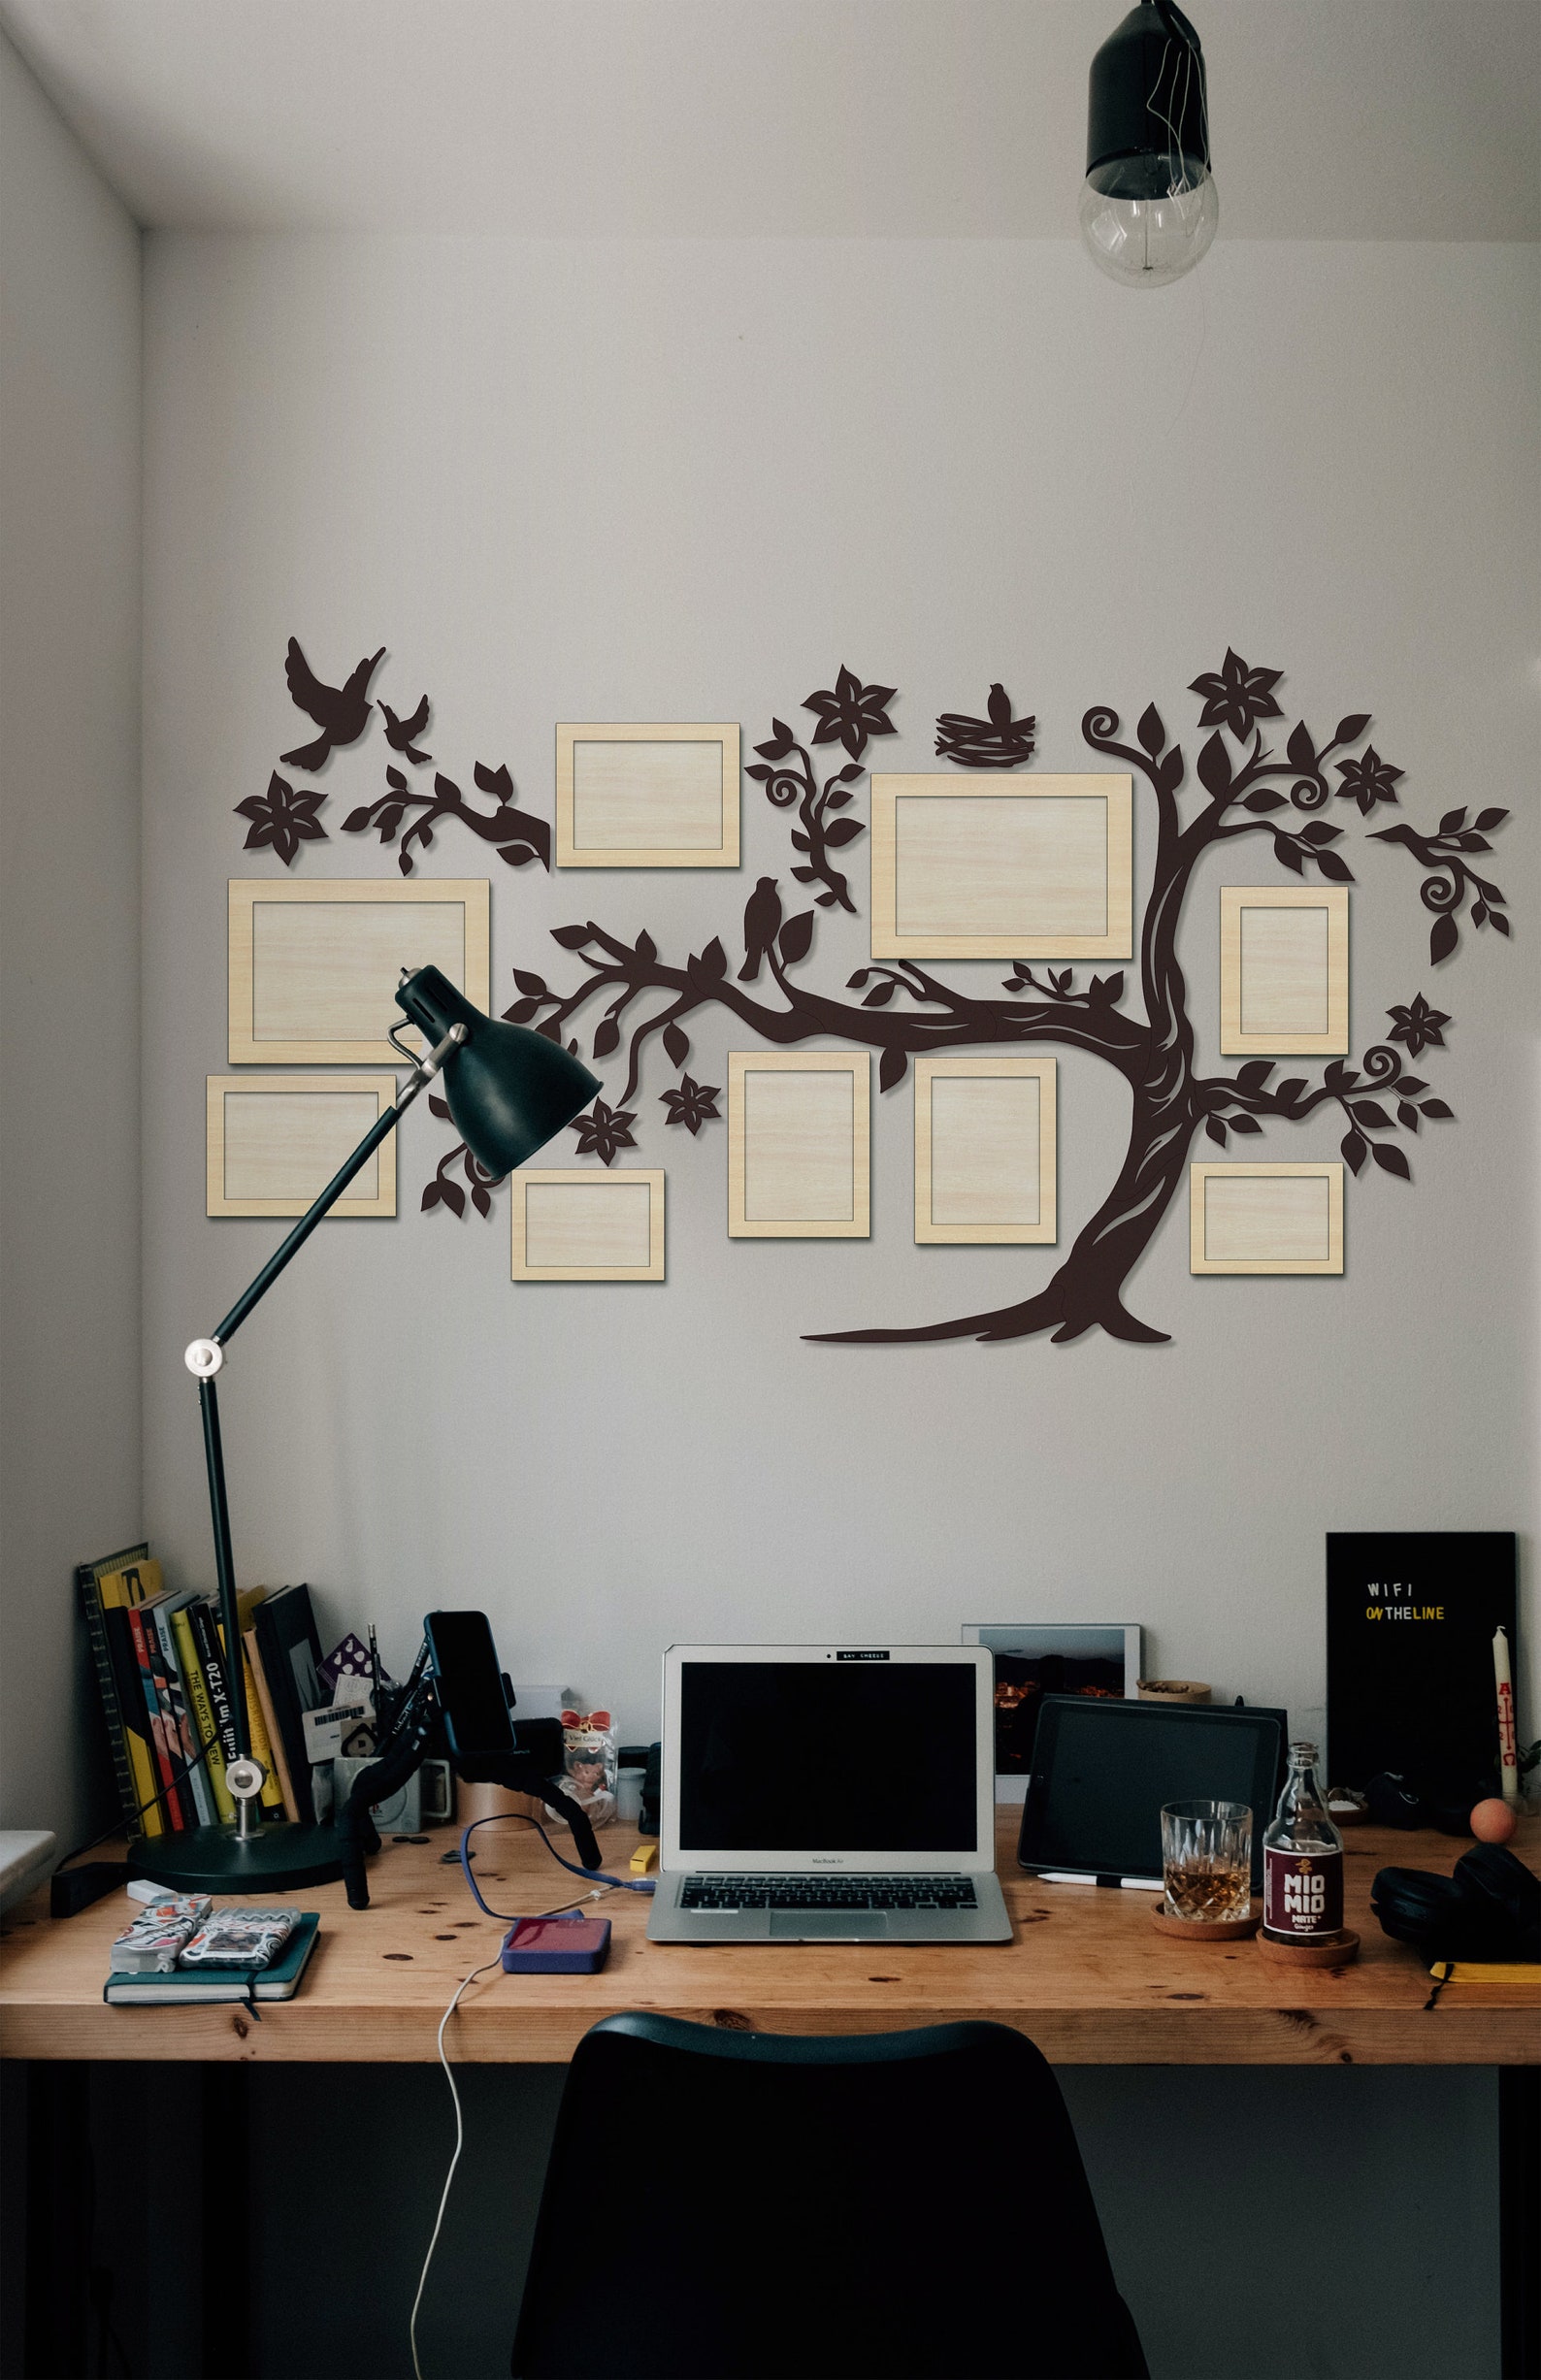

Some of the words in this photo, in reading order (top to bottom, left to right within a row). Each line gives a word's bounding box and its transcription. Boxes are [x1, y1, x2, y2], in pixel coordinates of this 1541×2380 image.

[1367, 1582, 1412, 1597] WIFI
[134, 1627, 145, 1653] PRAISE
[159, 1626, 170, 1652] PRAISE
[206, 1662, 227, 1704] X-T20
[189, 1671, 203, 1690] THE
[196, 1692, 210, 1721] WAYS
[203, 1723, 213, 1739] TO
[1284, 1874, 1325, 1894] MIO
[1284, 1894, 1325, 1913] MIO
[1292, 1914, 1317, 1924] MATE
